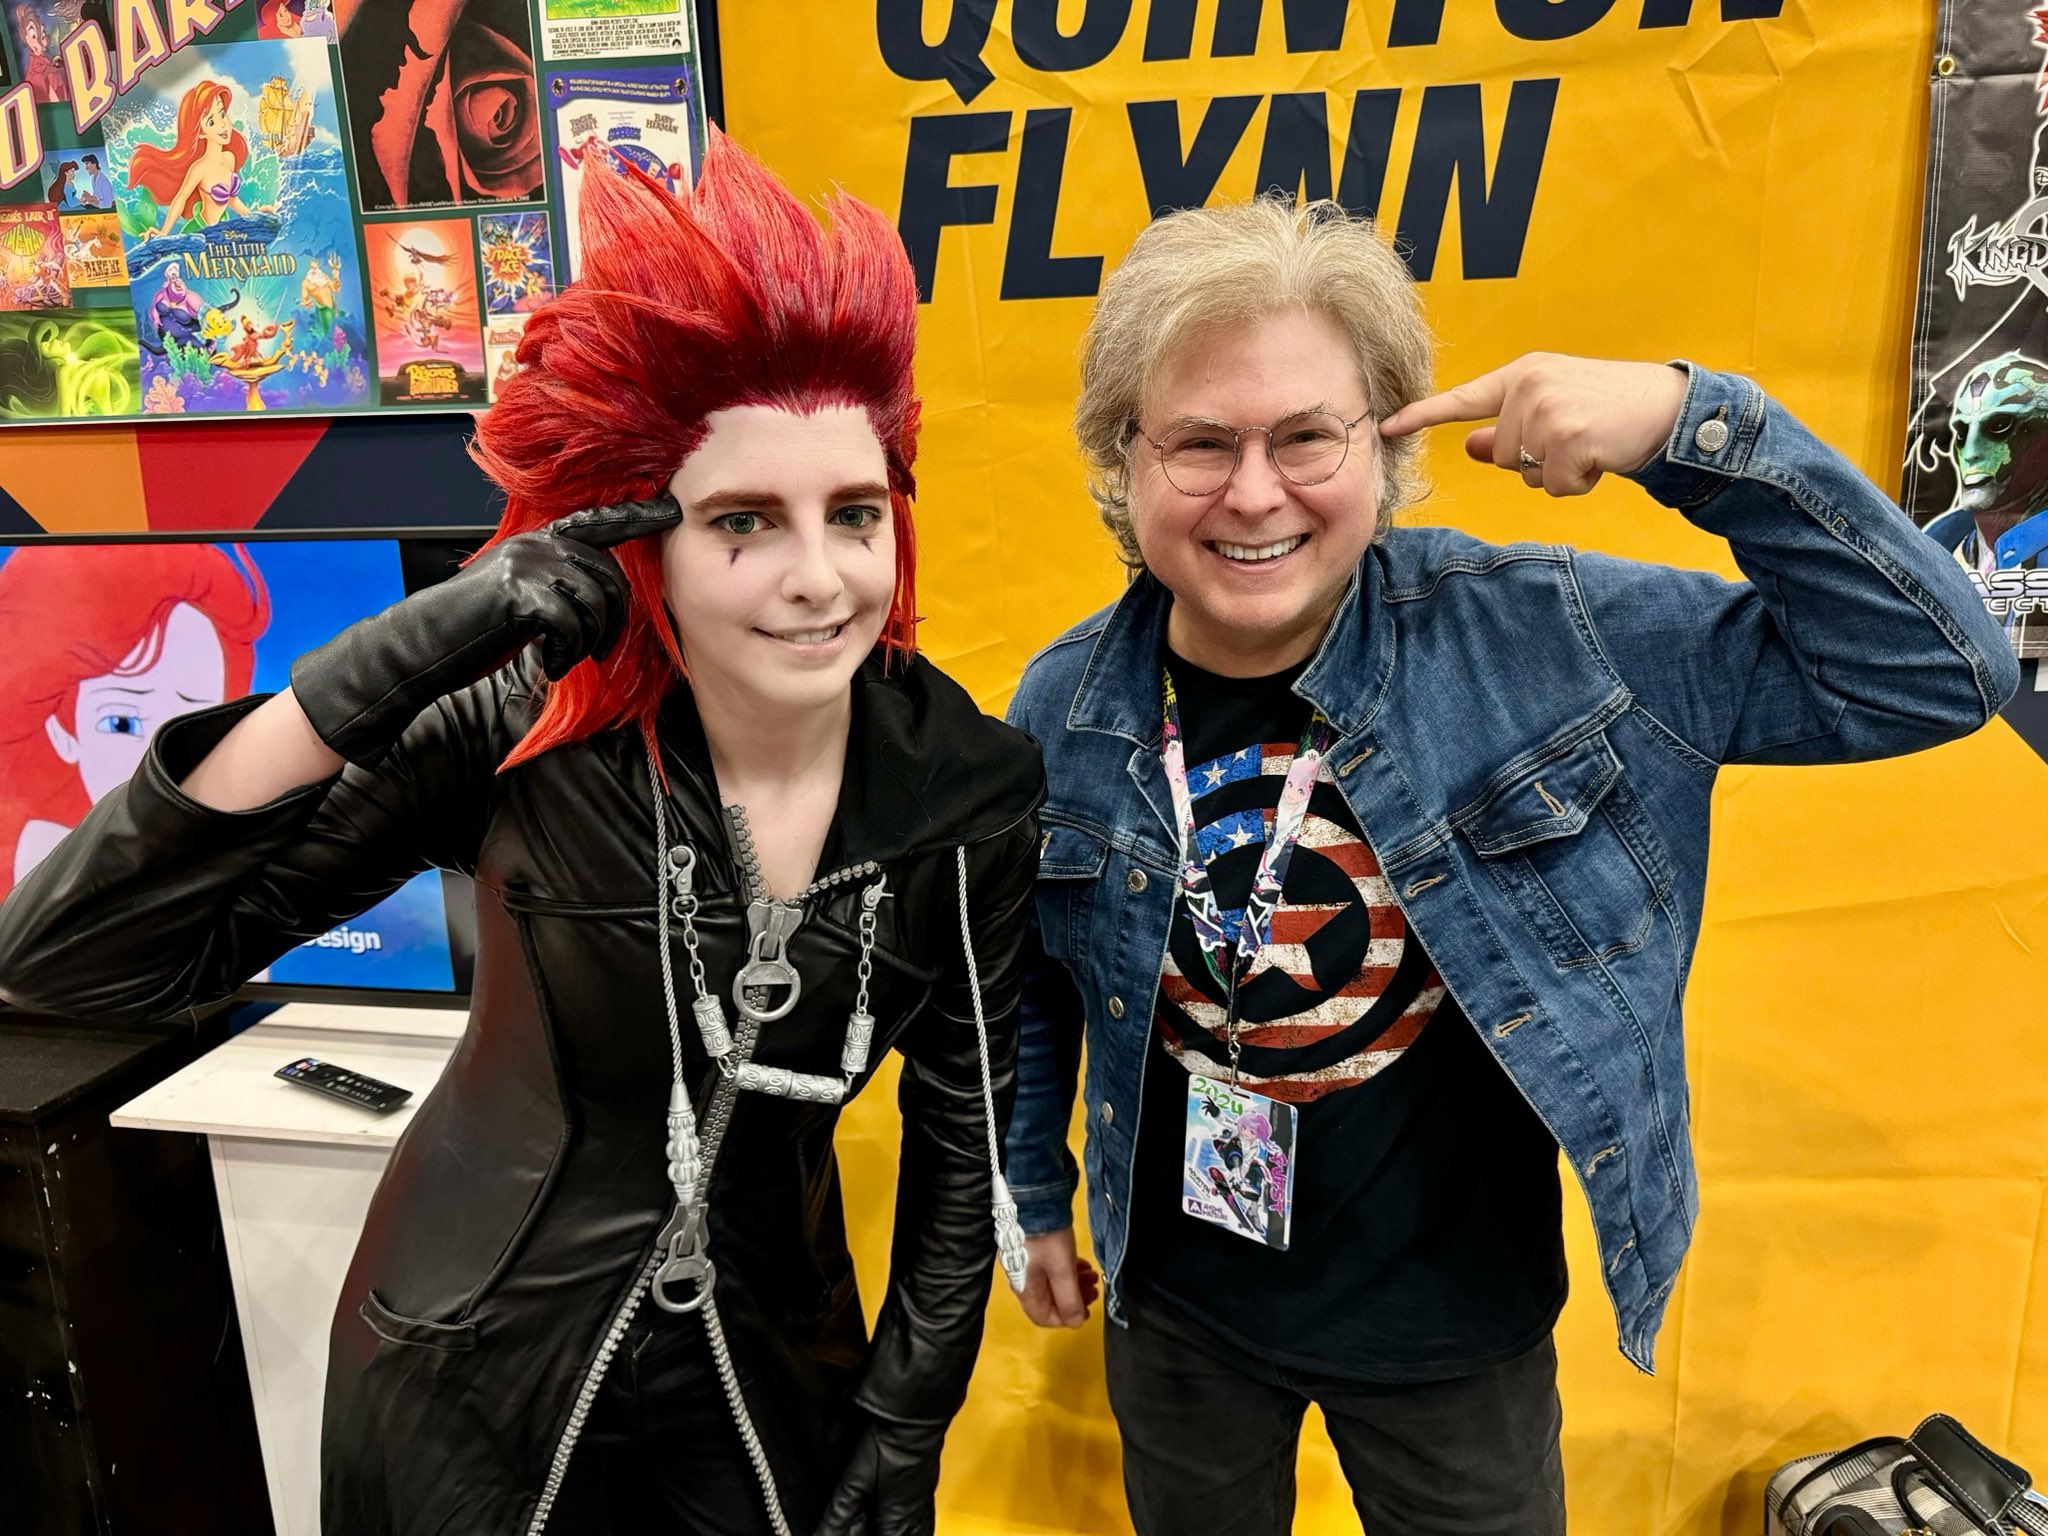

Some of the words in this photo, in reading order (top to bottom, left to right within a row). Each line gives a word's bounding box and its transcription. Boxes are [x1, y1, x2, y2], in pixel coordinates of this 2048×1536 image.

[60, 0, 247, 135] BAR
[897, 78, 1559, 304] FLYNN
[206, 242, 230, 257] THE
[231, 241, 267, 256] LITTLE
[183, 251, 296, 281] MERMAID
[500, 261, 521, 274] ACE
[1967, 571, 2048, 598] ASS
[304, 926, 381, 953] esign
[1191, 1077, 1243, 1116] 2024
